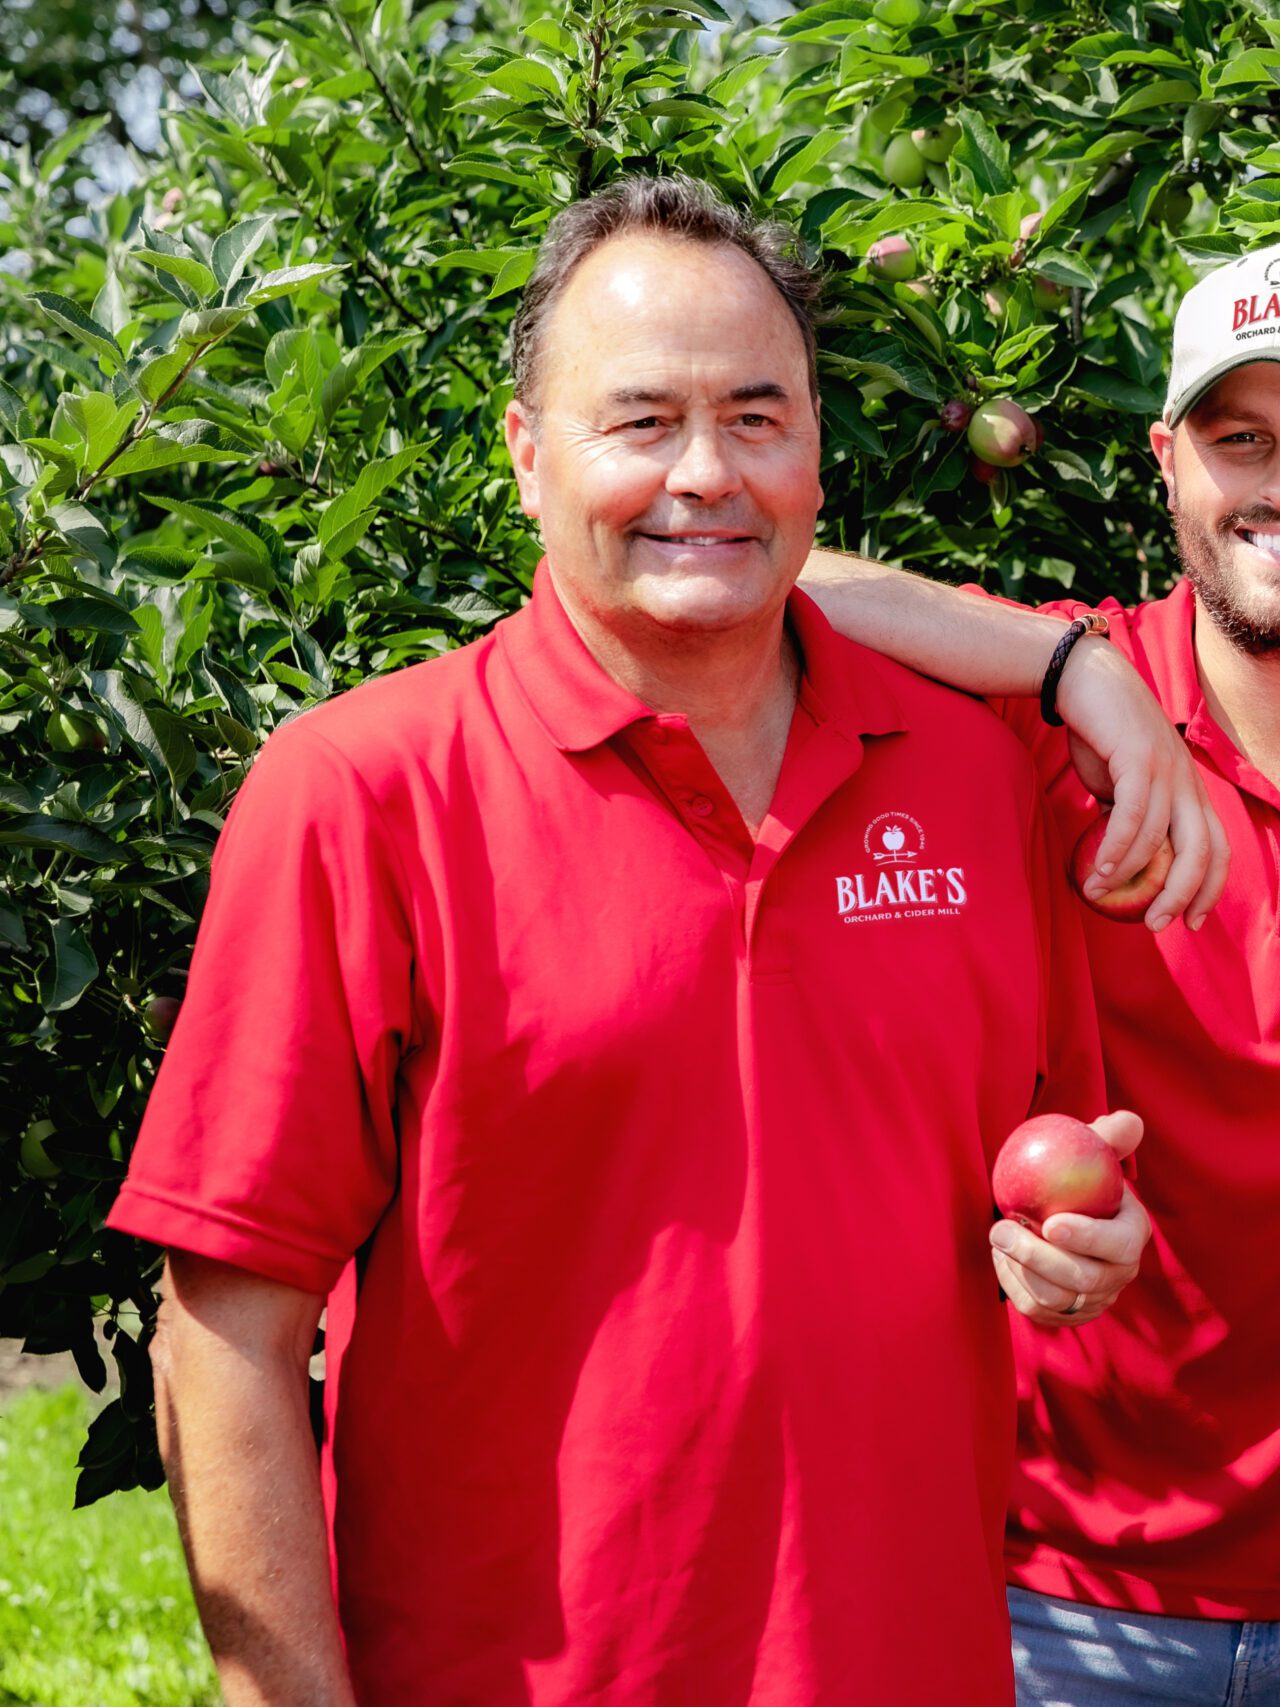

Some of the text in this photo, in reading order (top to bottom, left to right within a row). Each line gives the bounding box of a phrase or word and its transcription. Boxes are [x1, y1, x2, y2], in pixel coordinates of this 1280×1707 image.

[1236, 327, 1275, 341] ORCHARD
[864, 824, 873, 853] GROWING
[872, 813, 889, 825] GOOD
[835, 867, 967, 914] BLAKE'S
[844, 912, 892, 923] ORCHARD
[904, 909, 934, 917] CIDER
